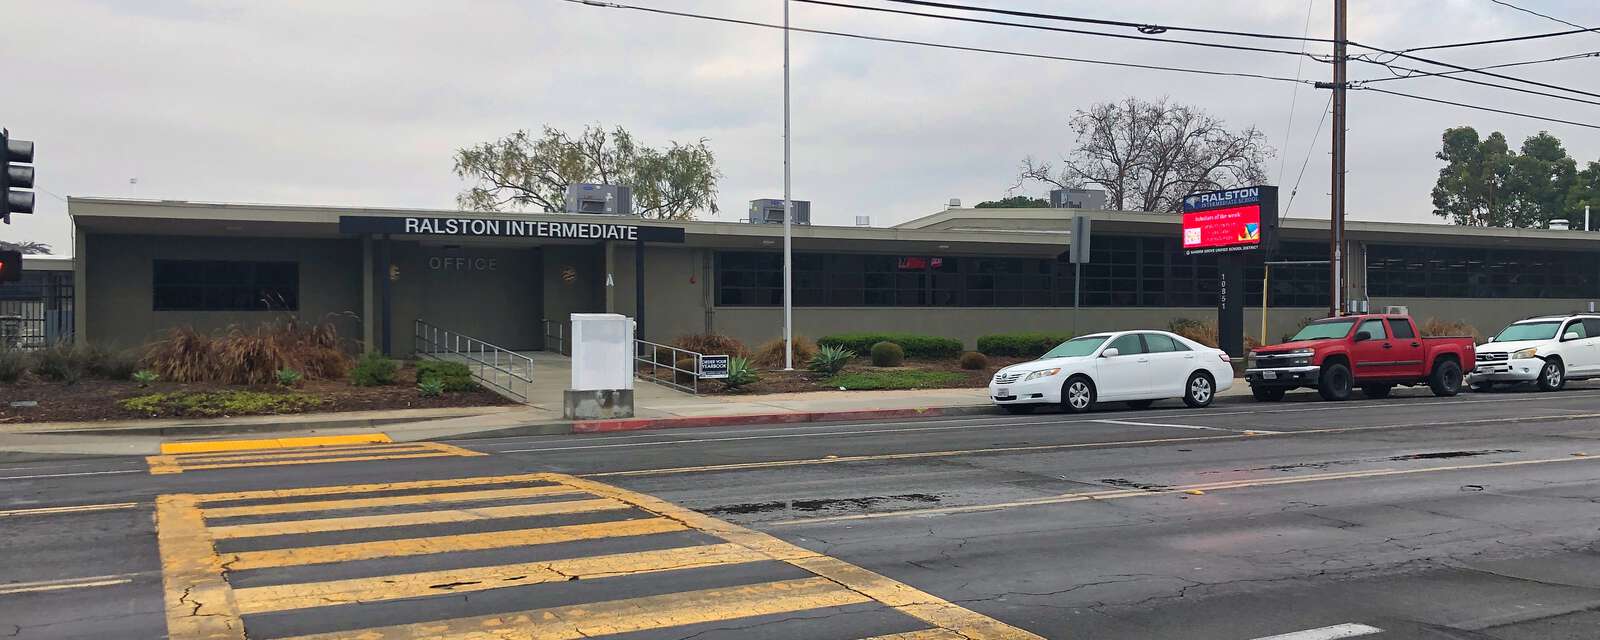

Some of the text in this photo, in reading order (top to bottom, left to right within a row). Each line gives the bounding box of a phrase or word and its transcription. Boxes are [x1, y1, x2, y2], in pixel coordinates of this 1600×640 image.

[1201, 187, 1259, 203] RALSTON
[405, 217, 638, 240] RALSTON INTERMEDIATE
[429, 257, 497, 270] OFFICE
[606, 273, 614, 287] A
